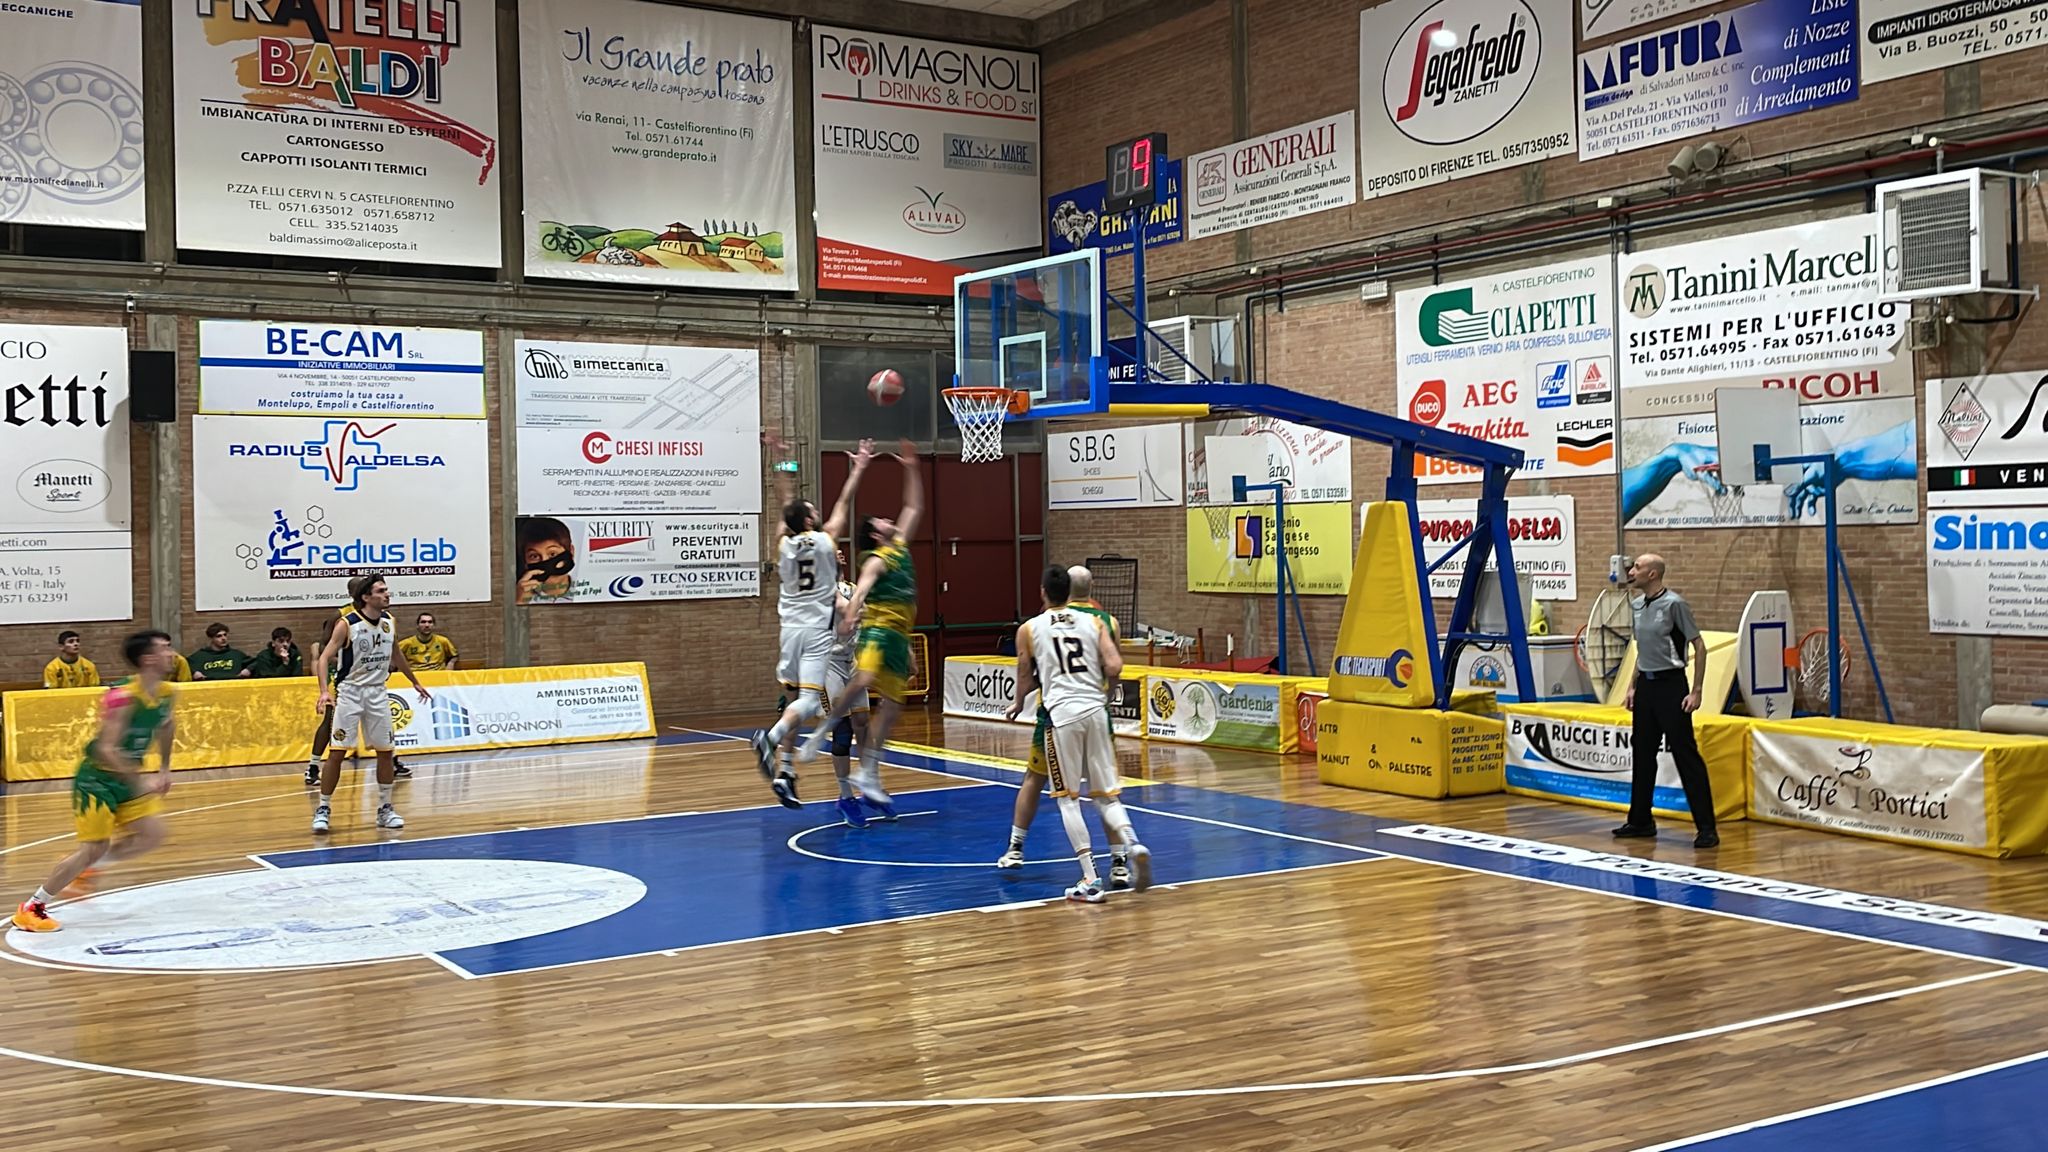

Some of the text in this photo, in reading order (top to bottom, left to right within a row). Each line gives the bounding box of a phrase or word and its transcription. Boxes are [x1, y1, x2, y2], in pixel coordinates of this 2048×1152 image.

[1783, 19, 1850, 50] di Nozze
[1877, 18, 1926, 40] IMPIANTI
[1879, 18, 2008, 59] Via Buozzi, 50
[1963, 38, 1997, 56] TEL.
[258, 36, 440, 108] BALDI
[600, 35, 707, 76] Grande
[715, 48, 774, 98] prato
[819, 34, 1036, 94] ROMAGNOLI
[1396, 12, 1526, 122] Segafredo
[1750, 44, 1851, 86] Complementi
[583, 74, 629, 90] vacanze
[631, 78, 658, 93] nella
[724, 88, 765, 106] toscana
[1453, 80, 1499, 103] ZANETTI
[1648, 69, 1710, 93] Salvadori Marco
[879, 80, 1037, 115] DRINKS & FOOD srl
[1666, 86, 1717, 106] Via Vallesi,
[1735, 77, 1851, 117] di Arredamento
[201, 105, 461, 140] IMBIANCATURA DI INTERNI ED ESTERNI
[576, 111, 738, 137] via Renai, Castelfiorentino
[1586, 101, 1709, 139] 50051 CASTELFIORENTINO
[1602, 112, 1721, 149] 0571 61511 Fax. 0571636713
[286, 135, 384, 153] CARTONGESSO
[625, 131, 704, 147] Tel. 0571.61744
[822, 124, 920, 154] L'ETRUSCO
[952, 138, 1028, 162] SKY MARE
[1233, 123, 1337, 178] GENERALI
[241, 151, 427, 177] CAPPOTTI ISOLANTI TERMICI
[612, 144, 717, 163] www.grandeprato.it
[1132, 138, 1151, 188] 9
[1368, 132, 1569, 192] DEPOSITO DI FIRENZE TEL. 055/7350952
[1233, 158, 1337, 196] Assicurazioni Generali S.p.A.
[227, 183, 455, 210] P.ZZA F.LLI CERVI CASTELFIORENTINO
[249, 200, 436, 222] TEL. 0571.635012 0571.658712
[908, 210, 960, 225] ALIVAL
[289, 216, 399, 234] CELL. 335.5214035
[269, 233, 418, 251] baldimassimo@aliceposta.it
[1503, 267, 1595, 292] CASTELFIORENTINO
[1666, 257, 1757, 301] Tanini
[1669, 293, 1766, 314] www.taninimarcello.it
[1491, 293, 1597, 340] CIAPETTI
[1629, 300, 1897, 348] SISTEMI PER L'UFFICIO
[266, 328, 403, 358] BE-CAM
[1434, 327, 1612, 363] FERRAMENTA COMPRESSA BULLONERIA
[1630, 322, 1897, 364] Tel. 0571.64995 Fax 0571.61643
[298, 361, 395, 371] INIZIATIVE IMMOBILIARI
[1661, 348, 1859, 376] Dante Alighieri, CASTELFIORENTINO
[258, 399, 435, 411] Montelupo, Empoli Castelfiorentino
[290, 390, 396, 400] costruiamo casa
[1463, 379, 1518, 408] AEG
[1416, 402, 1440, 414] DUCO
[1557, 418, 1613, 432] LECHLER
[230, 445, 323, 457] RADIUS
[616, 441, 703, 456] CHESI INFISSI
[1069, 434, 1116, 463] S.B.G
[33, 472, 92, 487] Manetti
[542, 468, 594, 477] SERRAMENTI
[713, 469, 739, 477] FERRO
[46, 489, 82, 502] Sport
[588, 520, 655, 538] SECURITY
[665, 522, 749, 532] www.securityca.it
[1265, 517, 1301, 530] Euenio
[307, 537, 457, 565] radius lab
[672, 535, 742, 547] PREVENTIVI
[680, 549, 735, 561] GRATUITI
[12, 566, 43, 577] Volta,
[273, 565, 453, 578] ANALISI MEDICHE DEL LAVORO
[651, 570, 757, 583] TECNO SERVICE
[797, 558, 814, 591] 5
[43, 578, 66, 591] Italy
[28, 593, 69, 603] 632391
[1053, 636, 1089, 674] 12
[536, 684, 638, 699] AMMINISTRAZIONI
[964, 666, 1016, 702] cieffe
[557, 694, 639, 707] CONDOMINIALI
[1218, 693, 1274, 712] Gardenia
[475, 711, 520, 723] STUDIO
[476, 719, 562, 735] GIOVANNONI
[1388, 762, 1433, 777] PALESTRE
[1869, 786, 1949, 820] Portici
